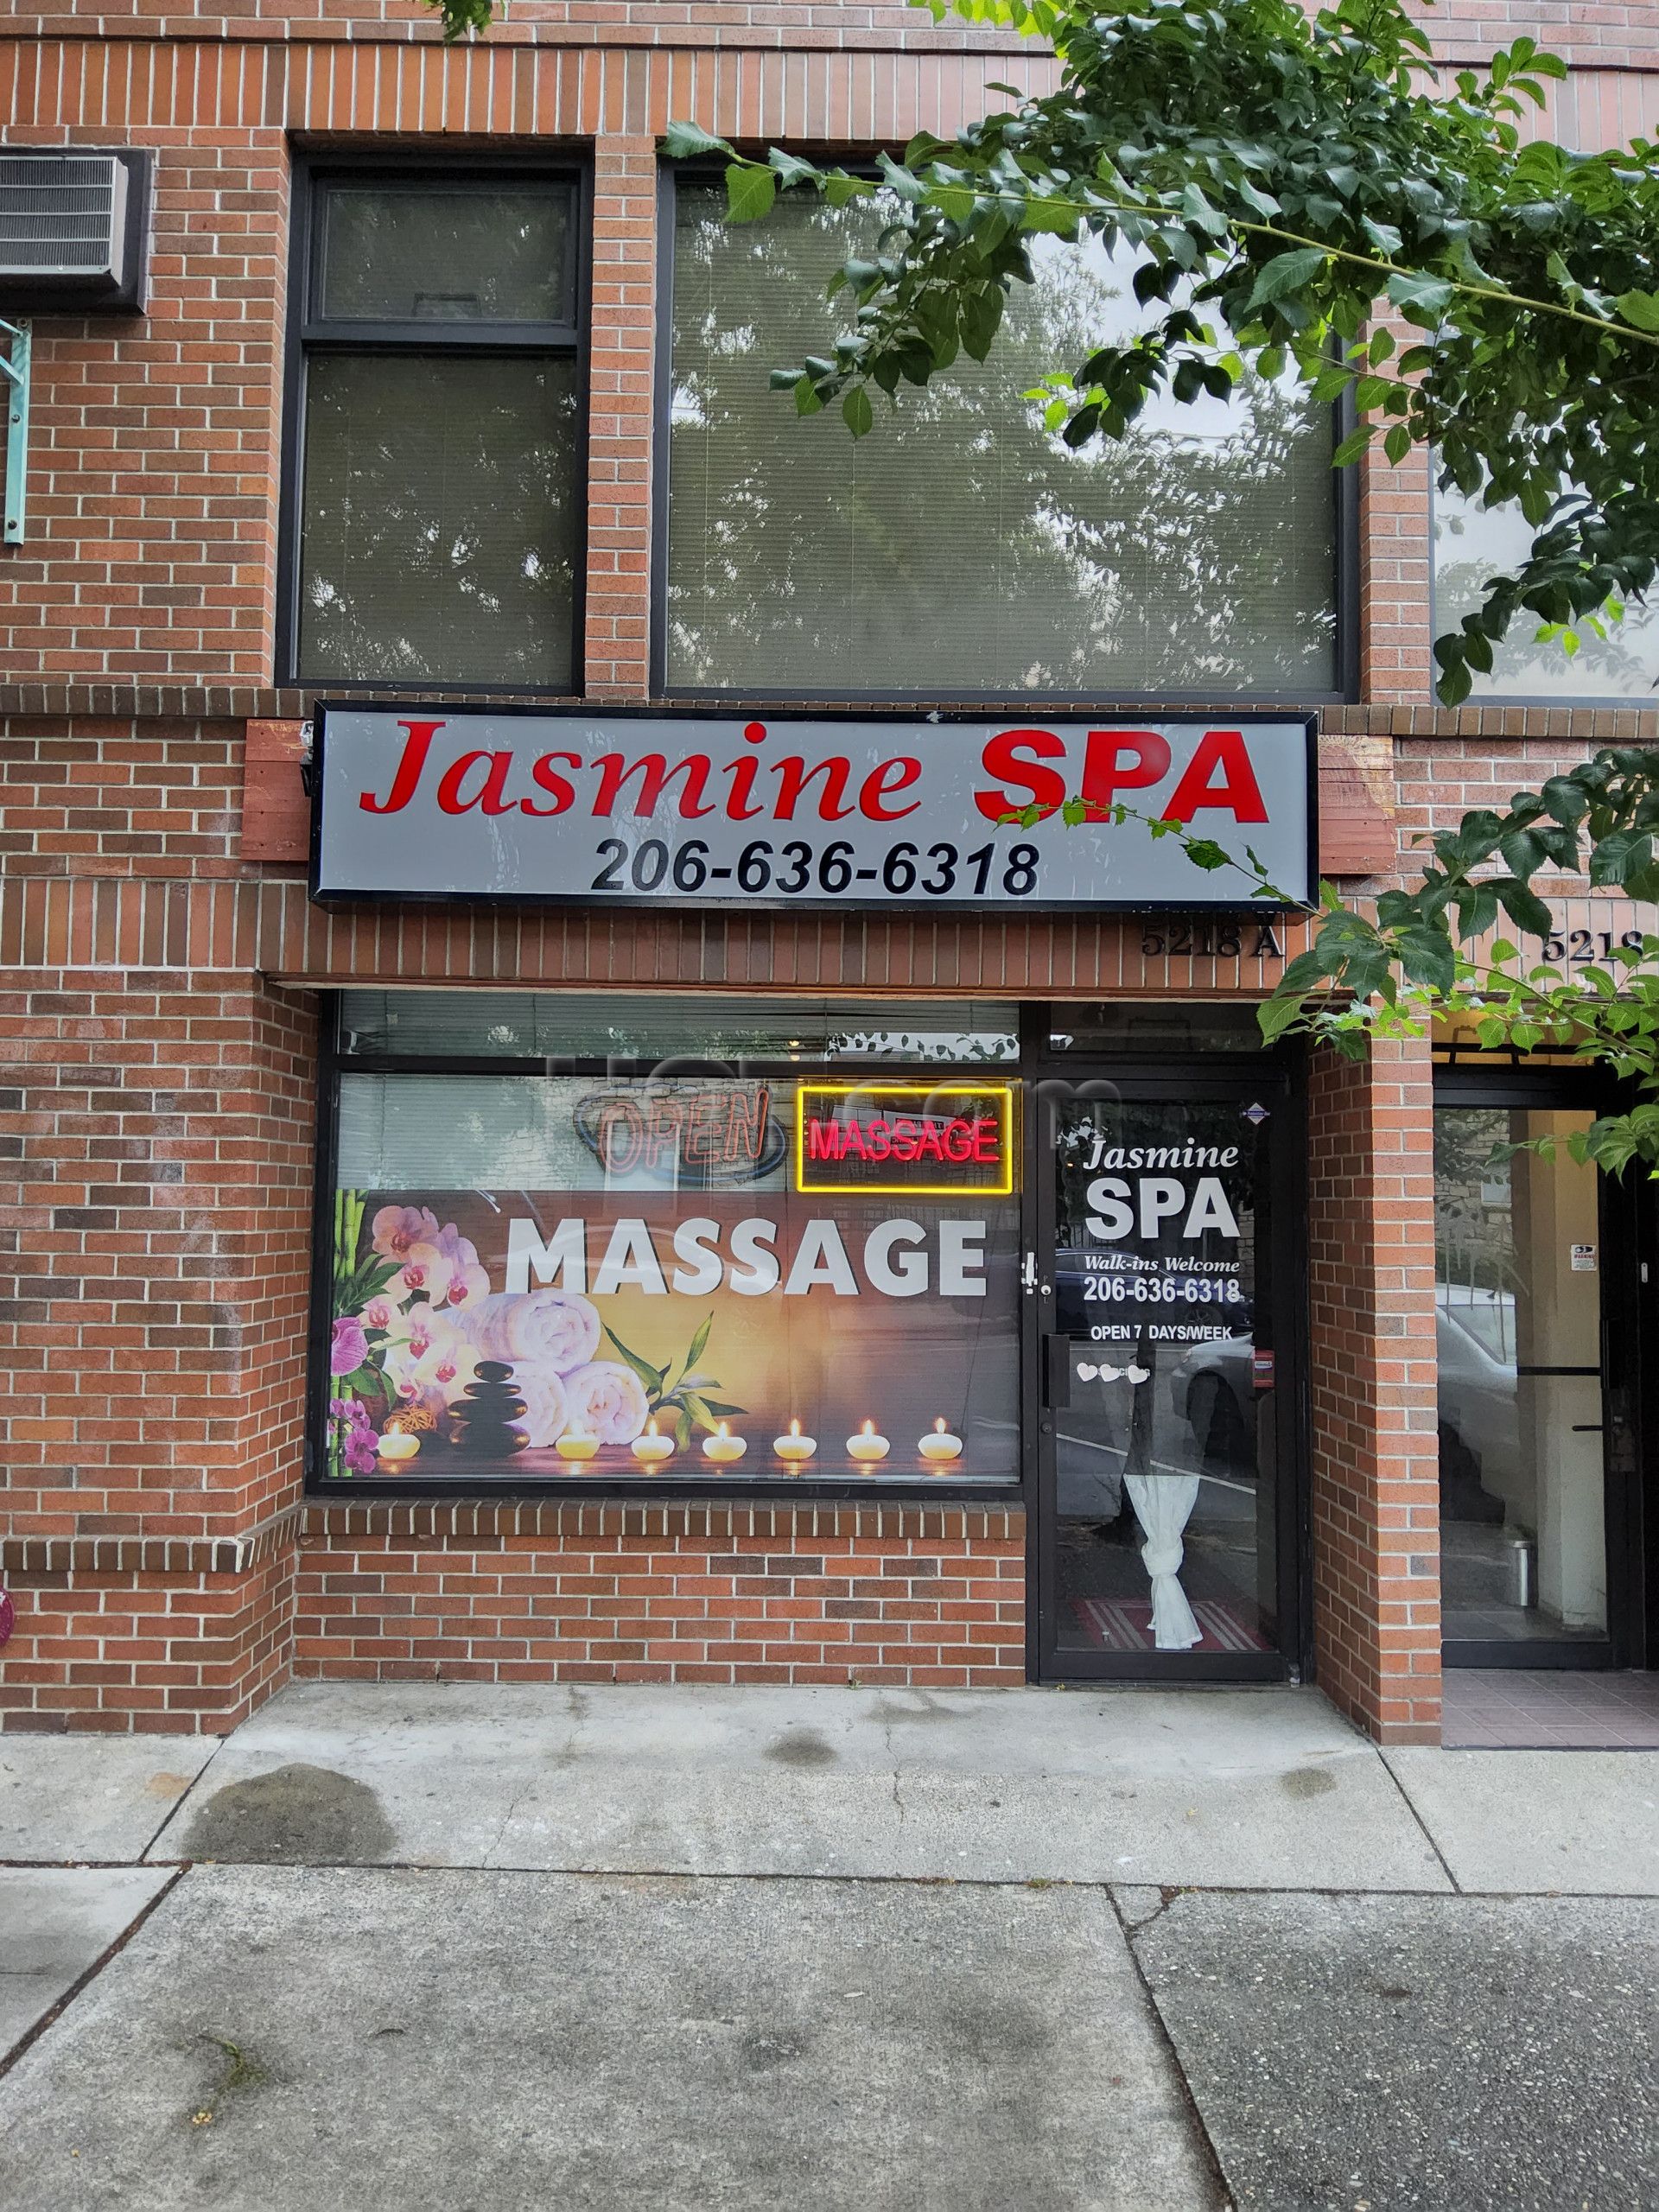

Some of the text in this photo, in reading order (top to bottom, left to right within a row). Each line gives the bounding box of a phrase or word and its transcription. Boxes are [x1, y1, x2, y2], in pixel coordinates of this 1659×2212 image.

[359, 720, 1270, 823] Jasmine SPA
[590, 837, 1041, 896] 206-636-6318
[1142, 922, 1286, 957] 5218 A
[596, 1086, 771, 1175] OPEN
[809, 1118, 1001, 1163] MASSAGE
[1083, 1137, 1240, 1170] Jasmine
[1084, 1177, 1242, 1240] SPA
[504, 1217, 988, 1298] MASSAGE
[1084, 1255, 1240, 1273] Walk-ins Welcome
[1084, 1276, 1241, 1303] 206-636-6318
[1090, 1325, 1130, 1340] OPEN
[1134, 1325, 1142, 1338] 7
